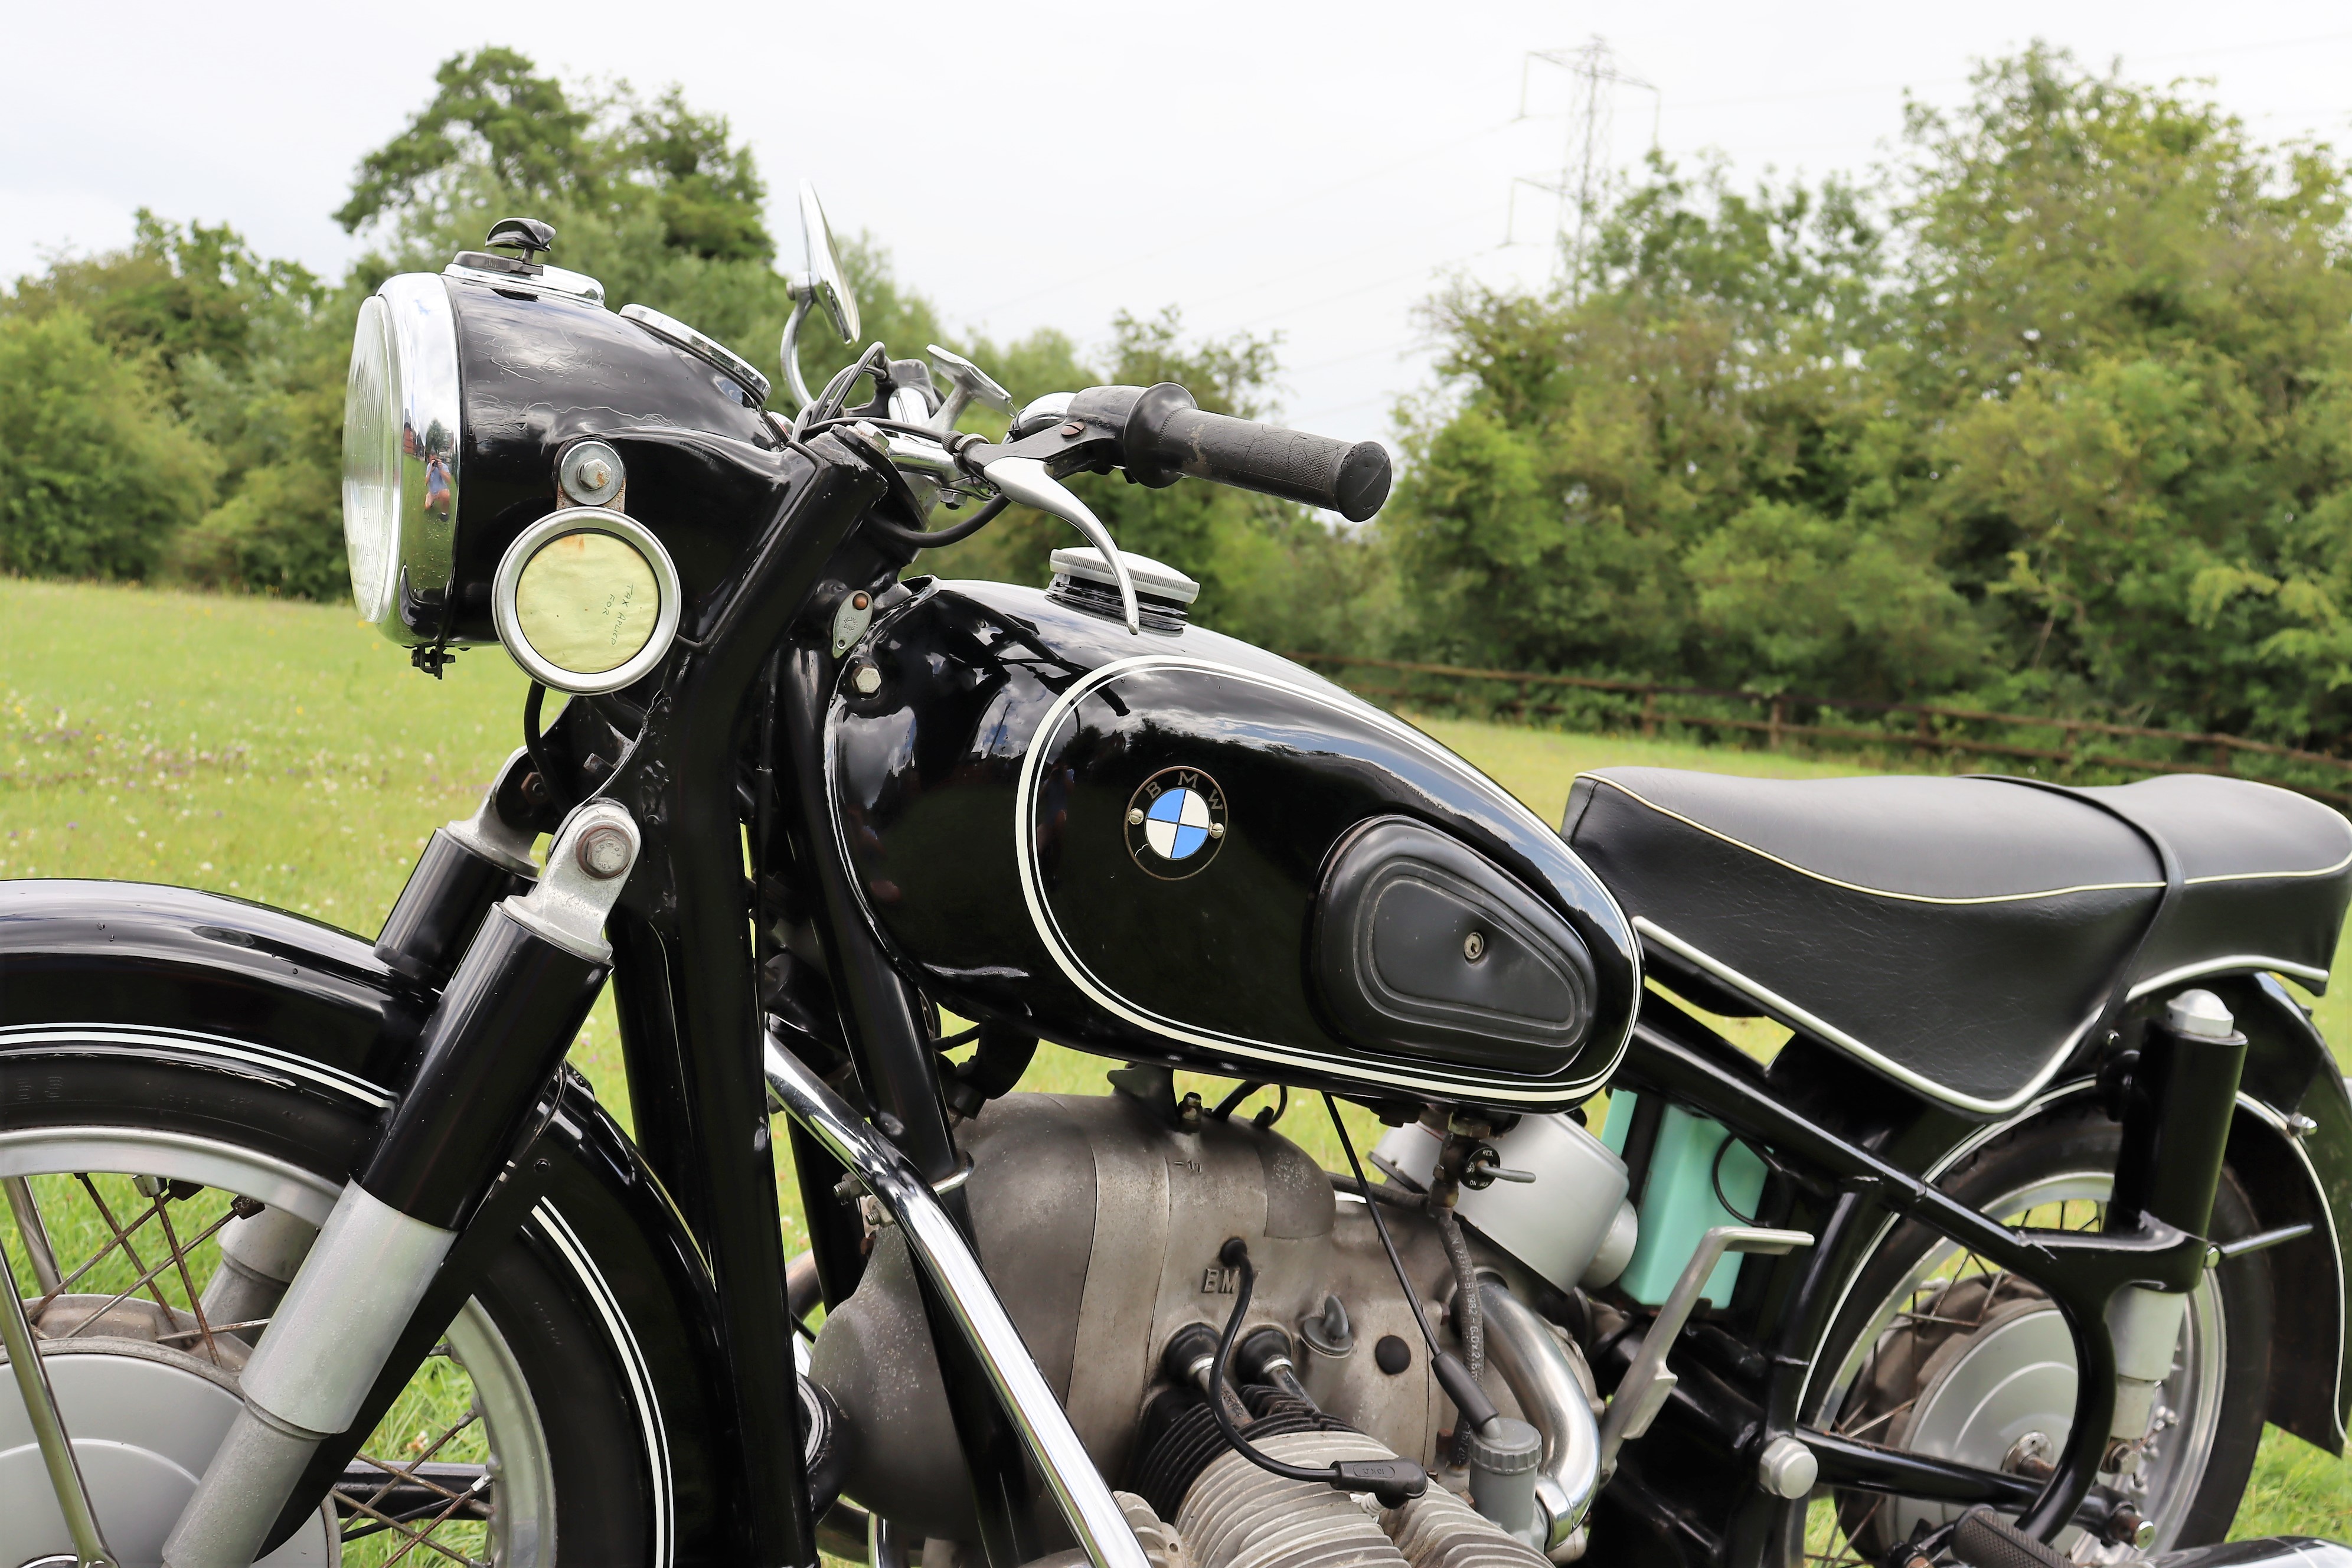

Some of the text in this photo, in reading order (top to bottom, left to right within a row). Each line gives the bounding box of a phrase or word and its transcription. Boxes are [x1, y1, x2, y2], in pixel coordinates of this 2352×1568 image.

[602, 593, 616, 616] FOR
[622, 582, 634, 607] TAX
[1144, 770, 1224, 810] BMW
[1201, 1267, 1261, 1294] BM
